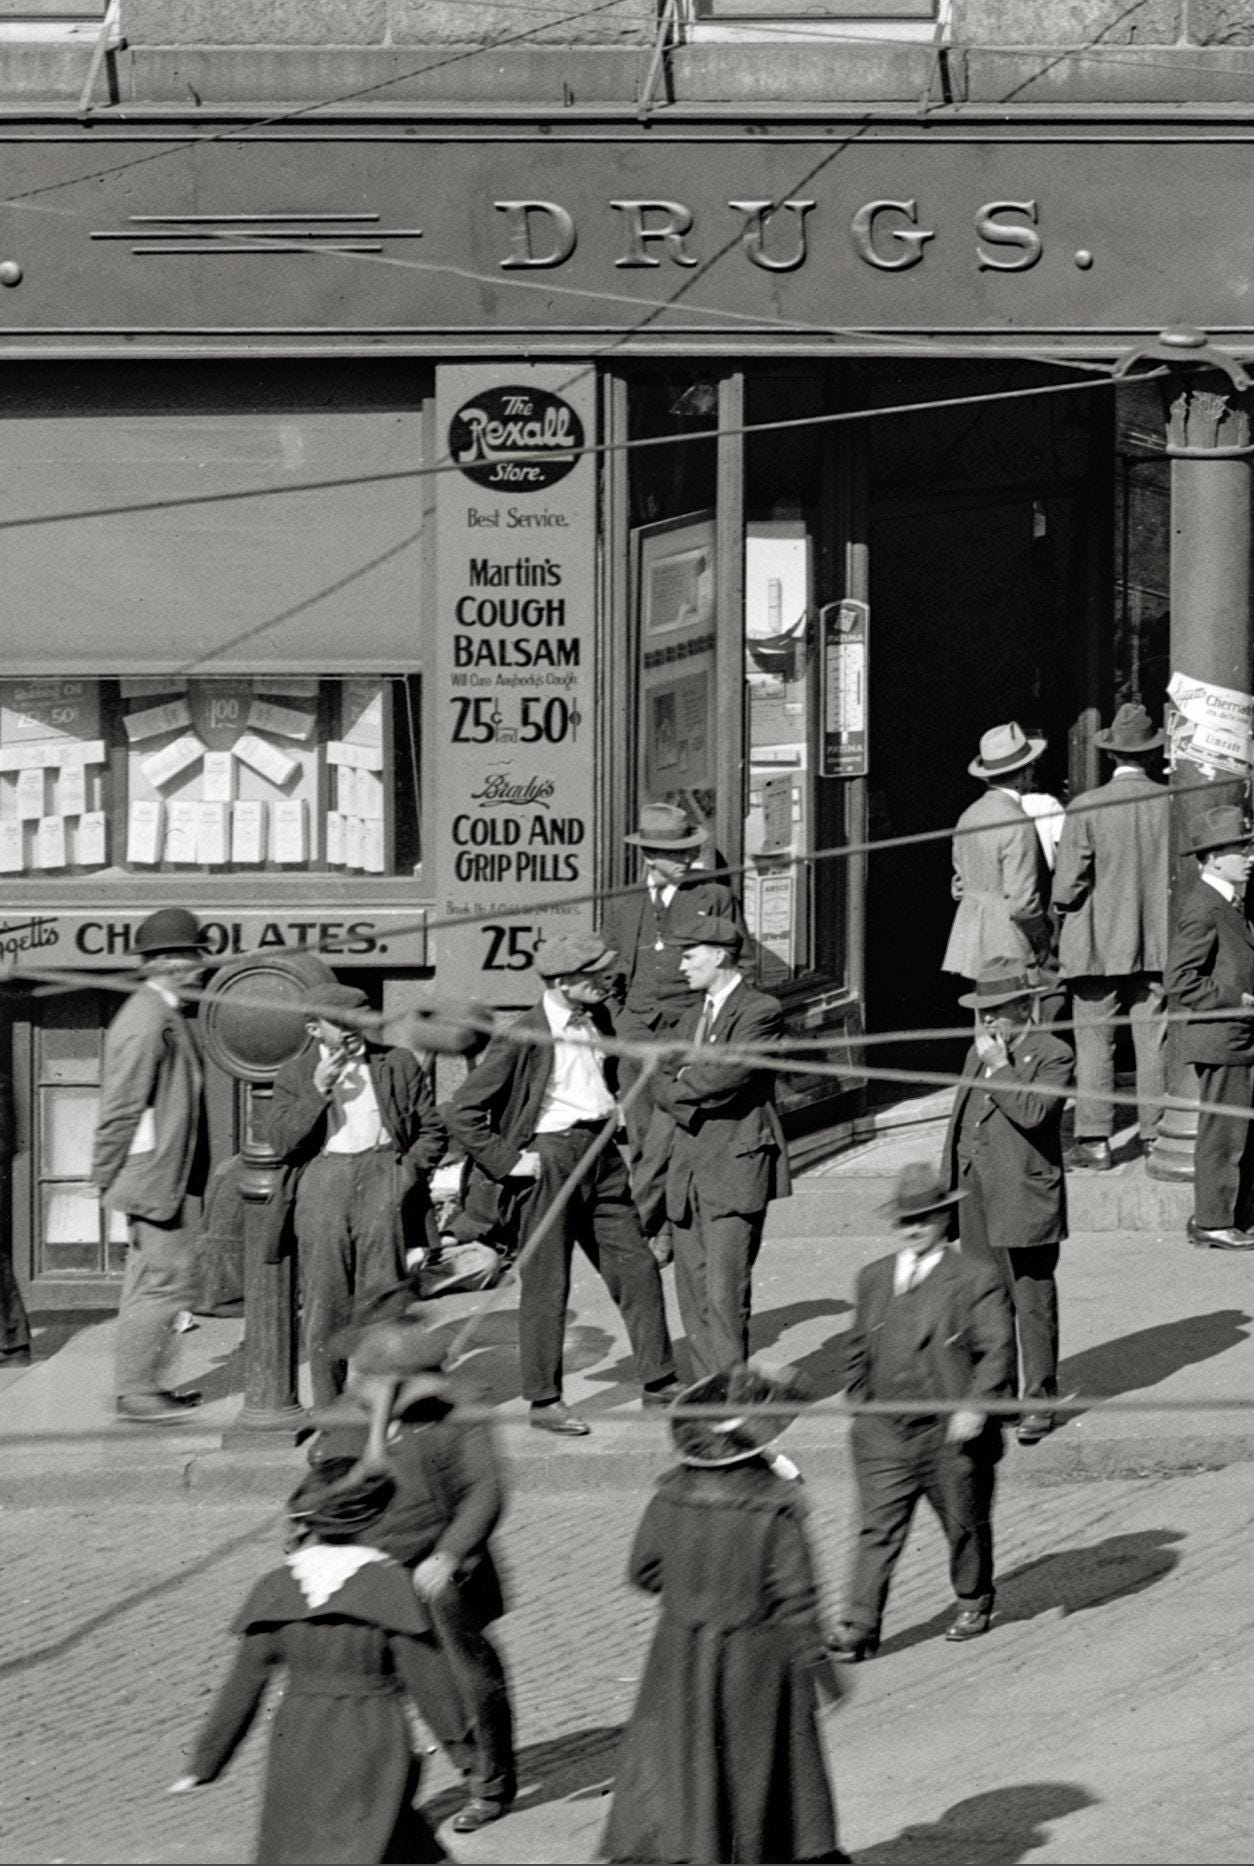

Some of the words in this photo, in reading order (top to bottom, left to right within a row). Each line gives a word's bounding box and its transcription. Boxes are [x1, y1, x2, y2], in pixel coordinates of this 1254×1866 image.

[493, 199, 1095, 272] DRUGS.
[501, 396, 533, 415] The
[459, 406, 575, 461] Rexall
[489, 463, 546, 482] Store.
[467, 508, 500, 528] Best
[507, 508, 569, 528] Service.
[469, 557, 562, 587] Martin's
[456, 595, 566, 627] COUGH
[454, 634, 581, 668] BALSAM
[471, 773, 555, 809] Brady's
[452, 814, 520, 846] COLD
[528, 815, 585, 846] AND
[455, 850, 512, 882] GRIP
[516, 851, 579, 882] PILLS
[75, 921, 389, 956] CHOLATES.
